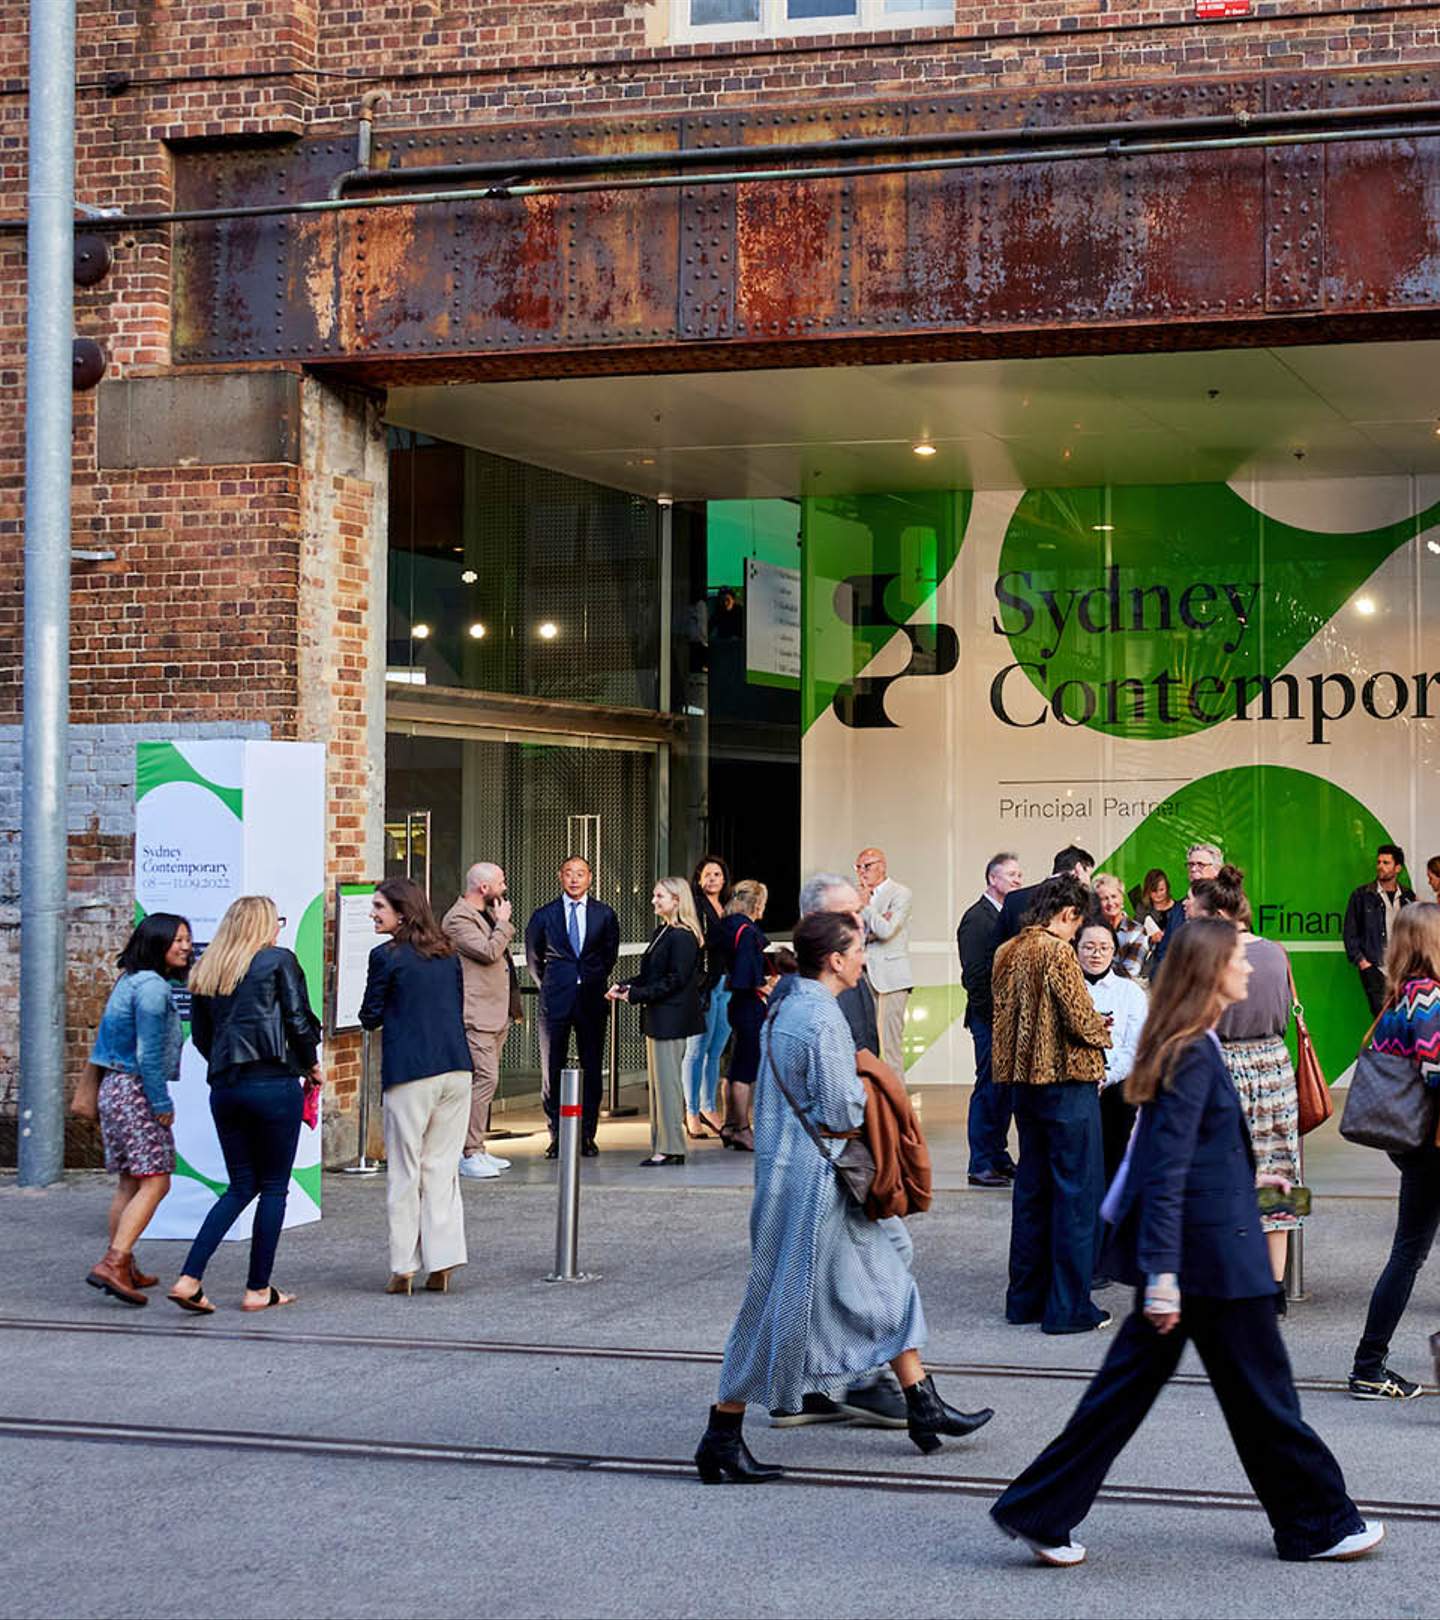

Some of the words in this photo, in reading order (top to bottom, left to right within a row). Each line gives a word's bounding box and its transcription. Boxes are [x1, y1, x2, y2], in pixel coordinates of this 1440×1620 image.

[992, 564, 1261, 659] Sydney
[999, 798, 1092, 822] Principal
[1104, 797, 1181, 817] Partner
[143, 845, 181, 861] Sydney
[143, 861, 228, 877] Contemporary
